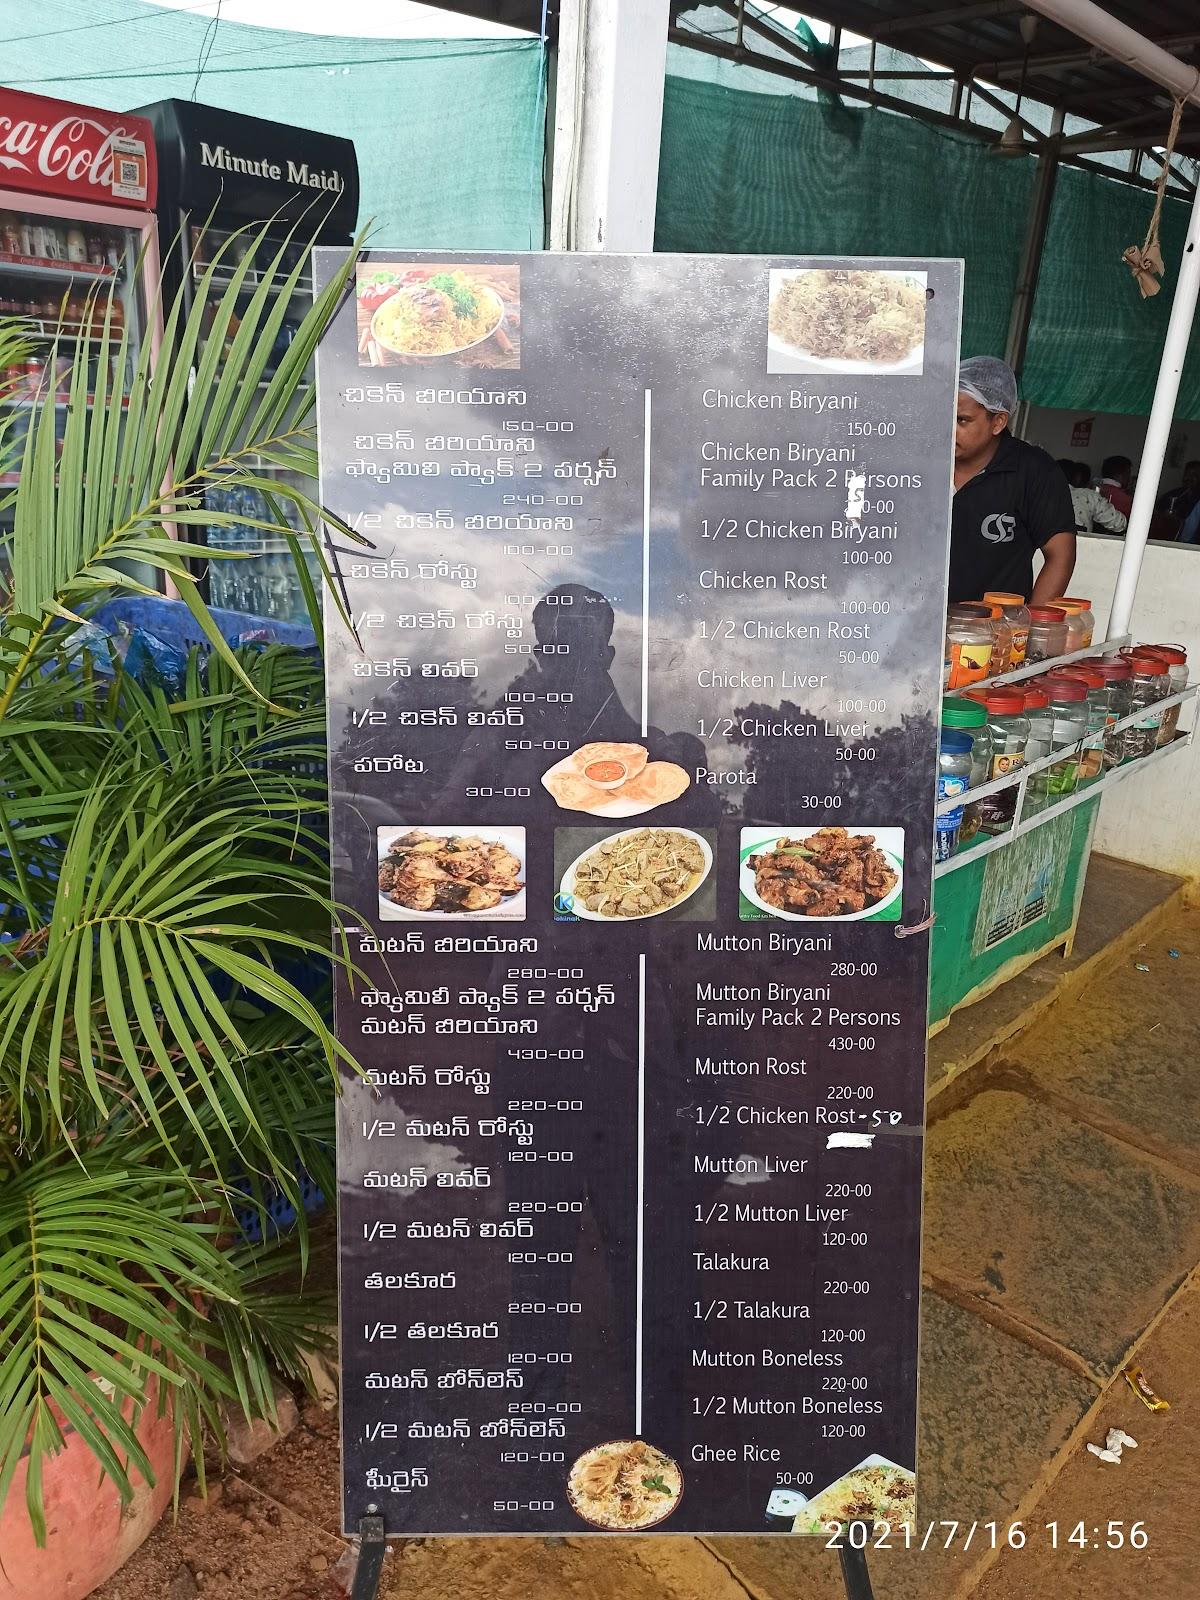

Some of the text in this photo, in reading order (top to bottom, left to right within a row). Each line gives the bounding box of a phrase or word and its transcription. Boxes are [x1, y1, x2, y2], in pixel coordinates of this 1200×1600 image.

[200, 142, 341, 192] Minute Maid
[702, 389, 858, 414] Chicken Biryani
[502, 421, 574, 432] 150-00
[847, 422, 896, 436] 150-00
[701, 441, 856, 466] Chicken Biryani
[524, 463, 543, 478] 2
[701, 467, 922, 491] Family Pack 2 Prsons
[503, 495, 583, 506] 240-00
[700, 518, 898, 543] 1/2 Chicken Biryani
[503, 545, 573, 556] 100-00
[842, 551, 892, 564] 100-00
[699, 570, 827, 589] Chicken Rost
[504, 595, 573, 605] 100-00
[840, 601, 890, 614] 100-00
[699, 619, 870, 640] 1/2 Chicken Rost
[504, 644, 569, 654] 50-00
[839, 651, 879, 664] 50-00
[697, 670, 827, 688] Chicken Liver
[504, 692, 573, 703] 100-00
[837, 700, 886, 713] 100-00
[352, 709, 387, 728] 1/2
[697, 718, 869, 739] 1/2 Chicken Liver
[505, 740, 569, 751] 50-00
[835, 748, 875, 761] 50-00
[696, 767, 757, 785] Parota
[466, 787, 530, 797] 30-00
[801, 796, 841, 809] 30-00
[697, 933, 832, 955] Mutton Biryani
[508, 968, 583, 979] 280-00
[830, 963, 877, 976] 280-00
[528, 990, 545, 1005] 2
[696, 983, 831, 1005] Mutton Biryani
[696, 1007, 901, 1030] Family Pack 2 Persons
[828, 1037, 875, 1050] 430-00
[508, 1049, 584, 1060] 430-00
[695, 1058, 807, 1075] Mutton Rost
[827, 1086, 874, 1100] 220-00
[508, 1100, 583, 1111] 220-00
[695, 1105, 856, 1126] 1/2 Chicken Rost
[362, 1119, 396, 1140] 1/2
[508, 1151, 573, 1162] 120-00
[694, 1156, 808, 1173] Mutton Liver
[825, 1184, 872, 1197] 220-00
[508, 1202, 583, 1213] 220-00
[694, 1203, 849, 1224] 1/2 Mutton Liver
[364, 1221, 397, 1241] 1/2
[823, 1232, 868, 1246] 120-00
[508, 1252, 573, 1263] 120-00
[693, 1252, 770, 1270] Talakura
[823, 1281, 870, 1294] 220-00
[508, 1303, 582, 1314] 220-00
[693, 1300, 811, 1321] 1/2 Talakura
[364, 1322, 397, 1343] 1/2
[821, 1329, 866, 1342] 120-00
[508, 1353, 573, 1363] 120-00
[692, 1349, 843, 1367] Mutton Boneless
[822, 1377, 868, 1390] 220-00
[508, 1402, 582, 1413] 220-00
[692, 1396, 883, 1416] 1/2 Mutton Boneless
[365, 1422, 398, 1442] 1/2
[821, 1425, 866, 1438] 120-00
[500, 1452, 565, 1463] 120-00
[691, 1444, 781, 1462] Ghee Rice
[776, 1472, 814, 1485] 50-00
[493, 1500, 554, 1511] 50-00
